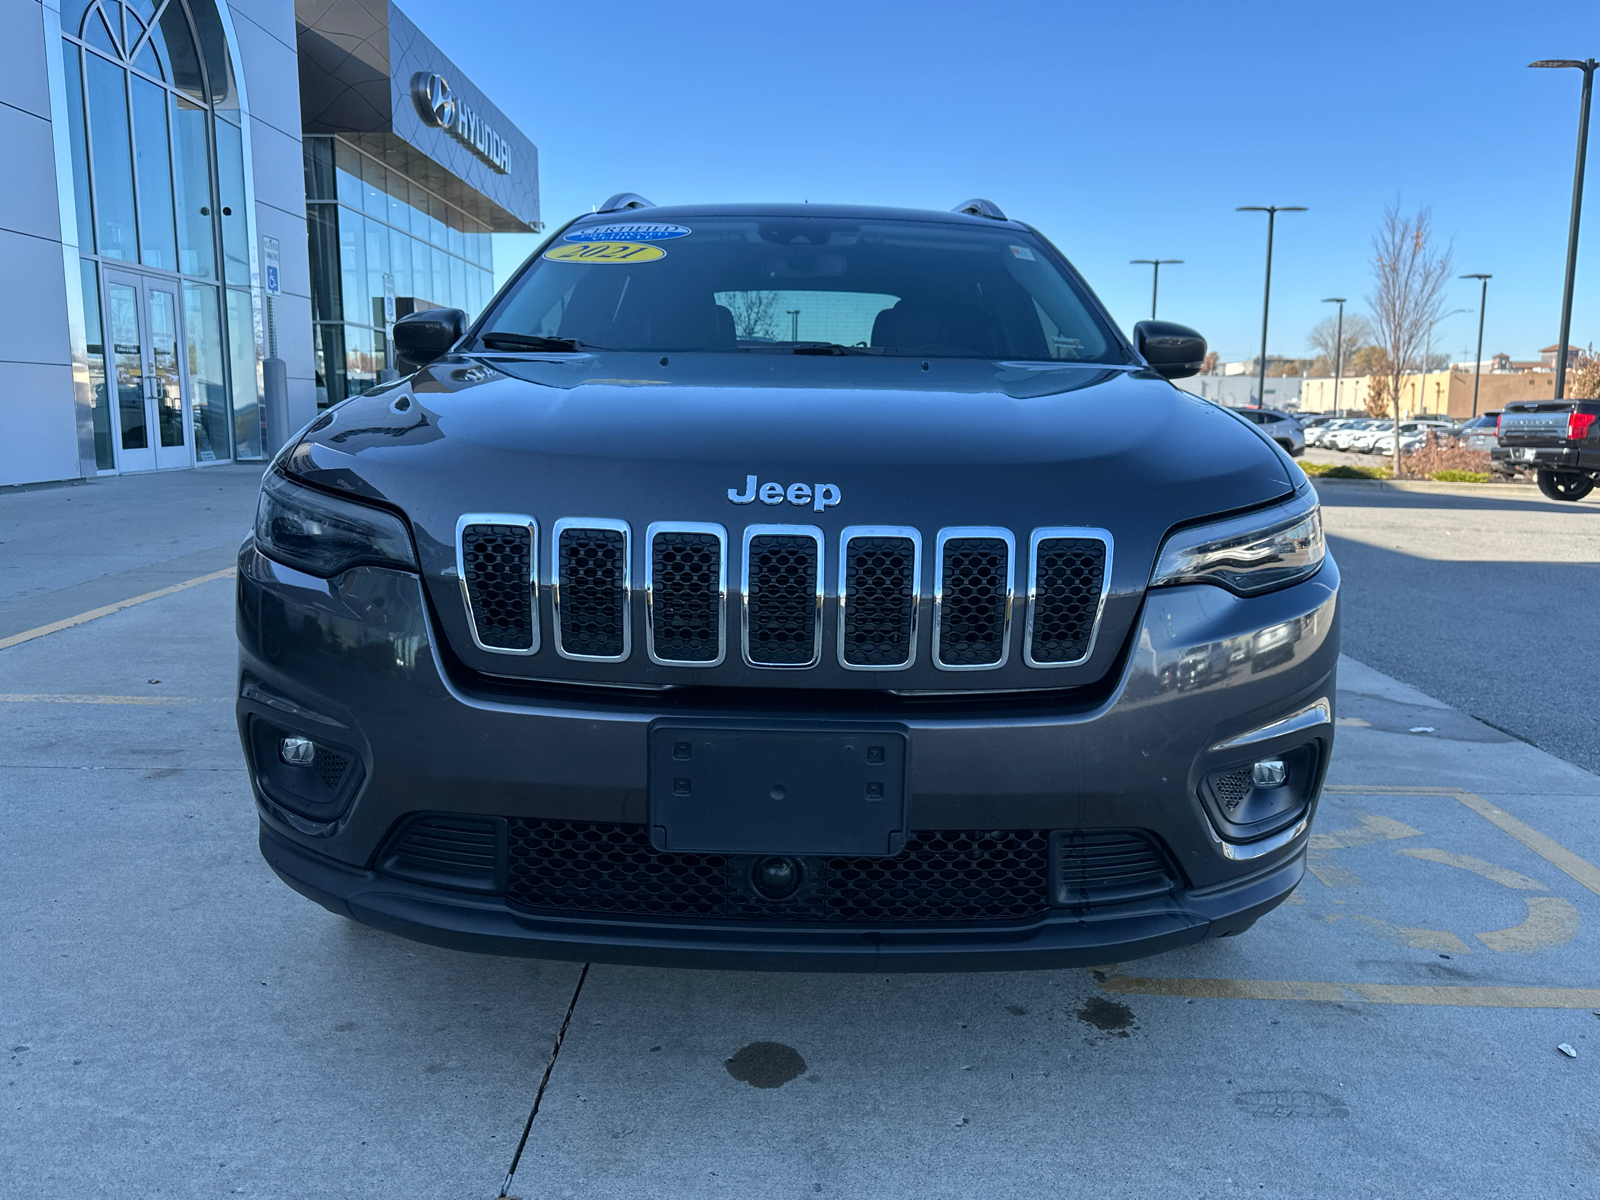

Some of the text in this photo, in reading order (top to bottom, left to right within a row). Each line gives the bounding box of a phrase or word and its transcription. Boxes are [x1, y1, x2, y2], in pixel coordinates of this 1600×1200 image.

[457, 97, 511, 175] HYUNDAI
[581, 225, 679, 235] CERTIFIED
[557, 245, 650, 259] 2021
[727, 474, 842, 513] Jeep
